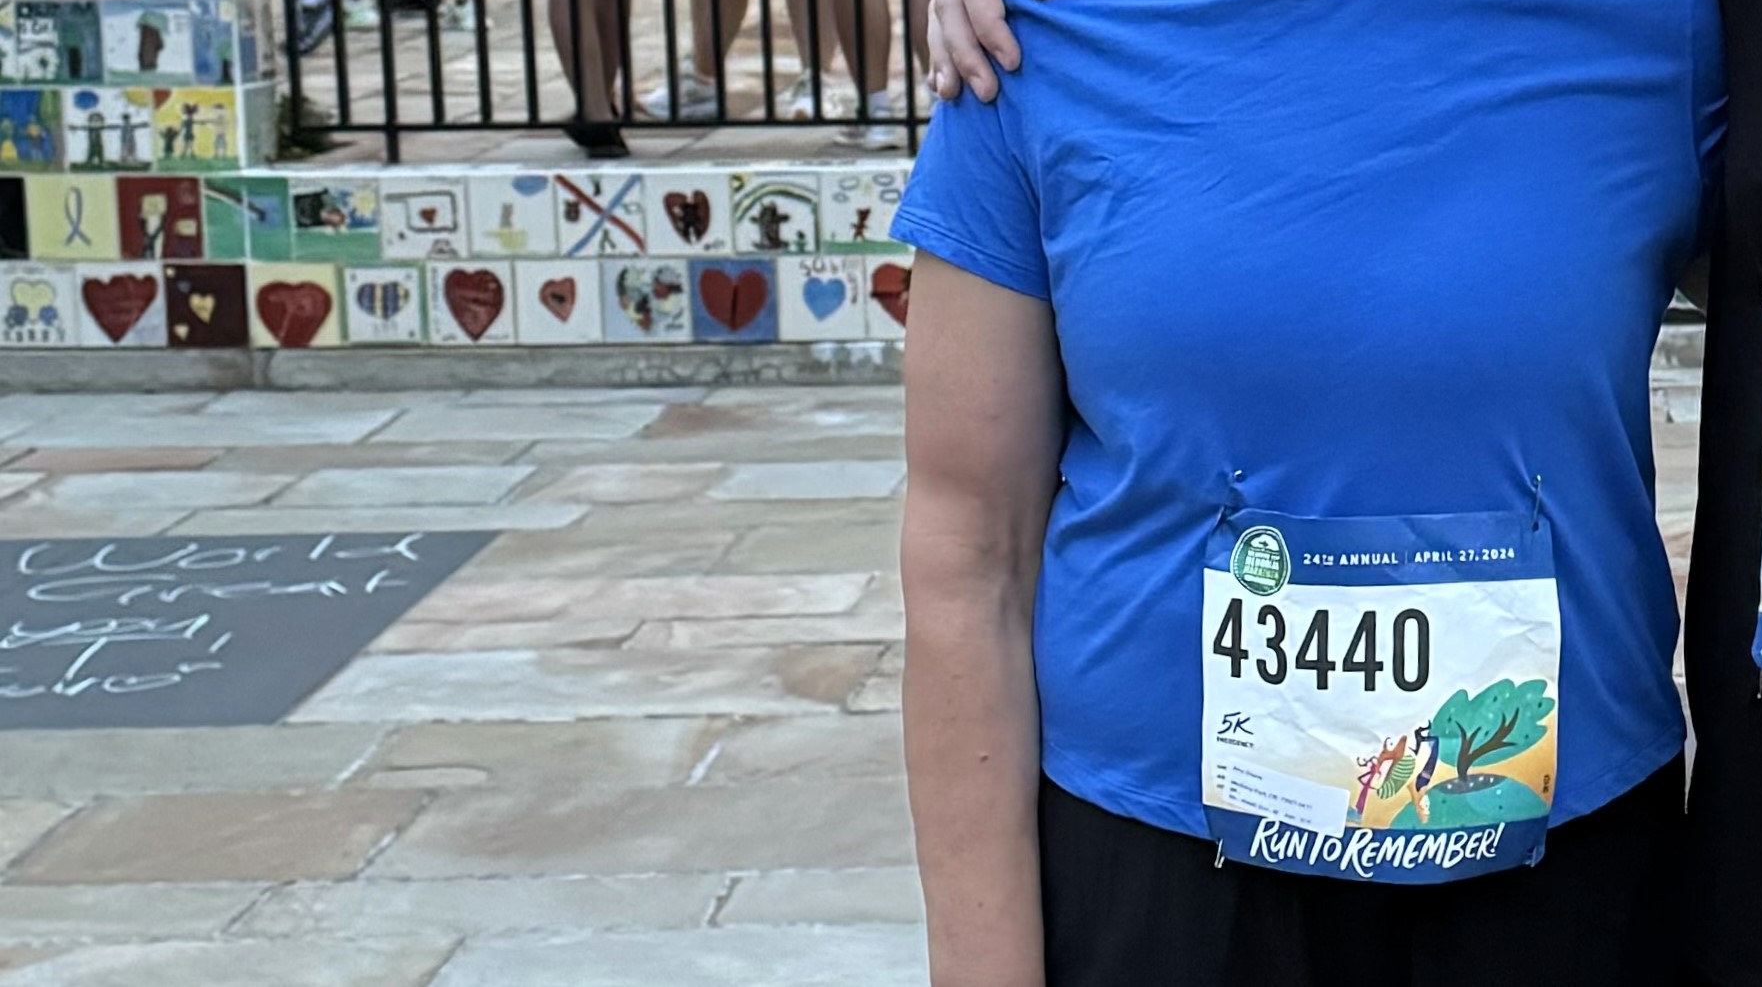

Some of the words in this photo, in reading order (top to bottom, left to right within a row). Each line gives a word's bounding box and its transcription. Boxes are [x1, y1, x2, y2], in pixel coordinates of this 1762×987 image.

[1338, 552, 1399, 566] ANNUAL
[1413, 550, 1454, 564] APRIL
[1212, 598, 1431, 692] 43440
[1217, 711, 1255, 736] 5K
